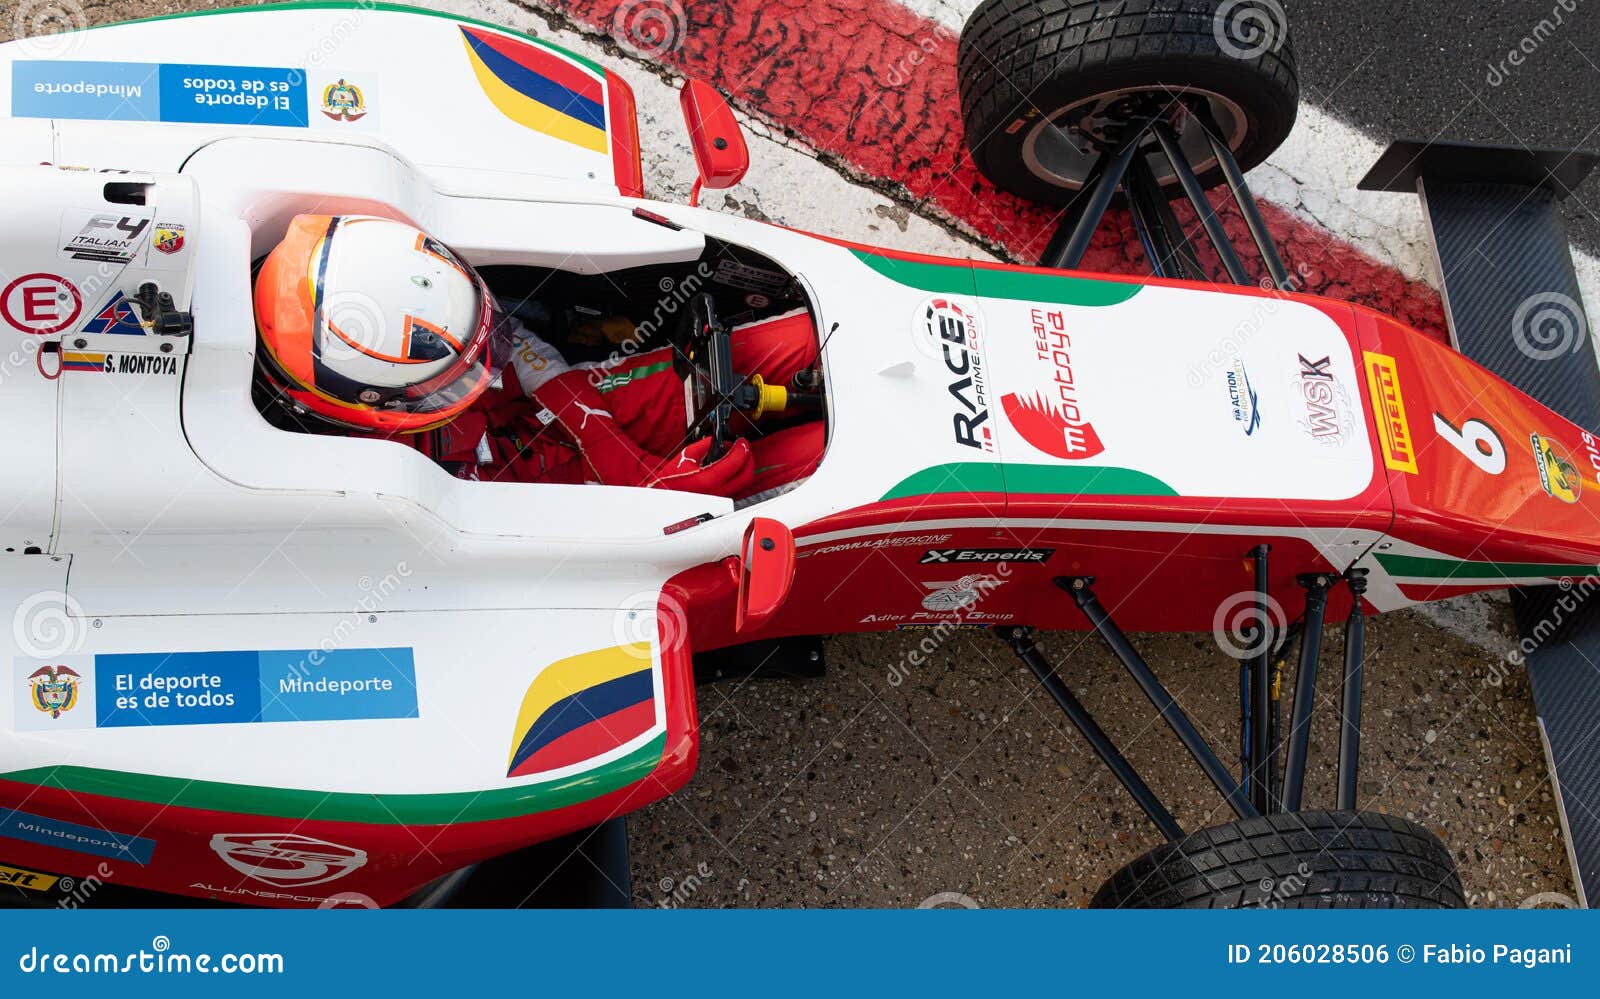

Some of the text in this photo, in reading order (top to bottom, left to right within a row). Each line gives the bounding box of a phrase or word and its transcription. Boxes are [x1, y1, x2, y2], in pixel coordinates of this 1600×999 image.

[34, 82, 142, 97] Mindeporte
[183, 77, 289, 93] es de todos
[195, 93, 290, 110] El deporte
[78, 214, 150, 240] F4
[71, 235, 132, 248] ITALIAN
[23, 286, 59, 321] E
[104, 354, 177, 375] S. MONTOYA
[939, 314, 989, 450] RACE
[1227, 371, 1240, 407] ACTION
[1297, 352, 1340, 438] WSK
[1372, 362, 1411, 464] PIRELLI
[1432, 410, 1508, 475] 6
[956, 550, 1044, 562] Experis
[859, 611, 1014, 623] Adler Pelzer Group
[115, 672, 393, 696] El deporte Mindeporte
[115, 690, 235, 709] es de todos
[17, 821, 130, 851] Mindeporte
[190, 882, 364, 905] ALLINSPORTS
